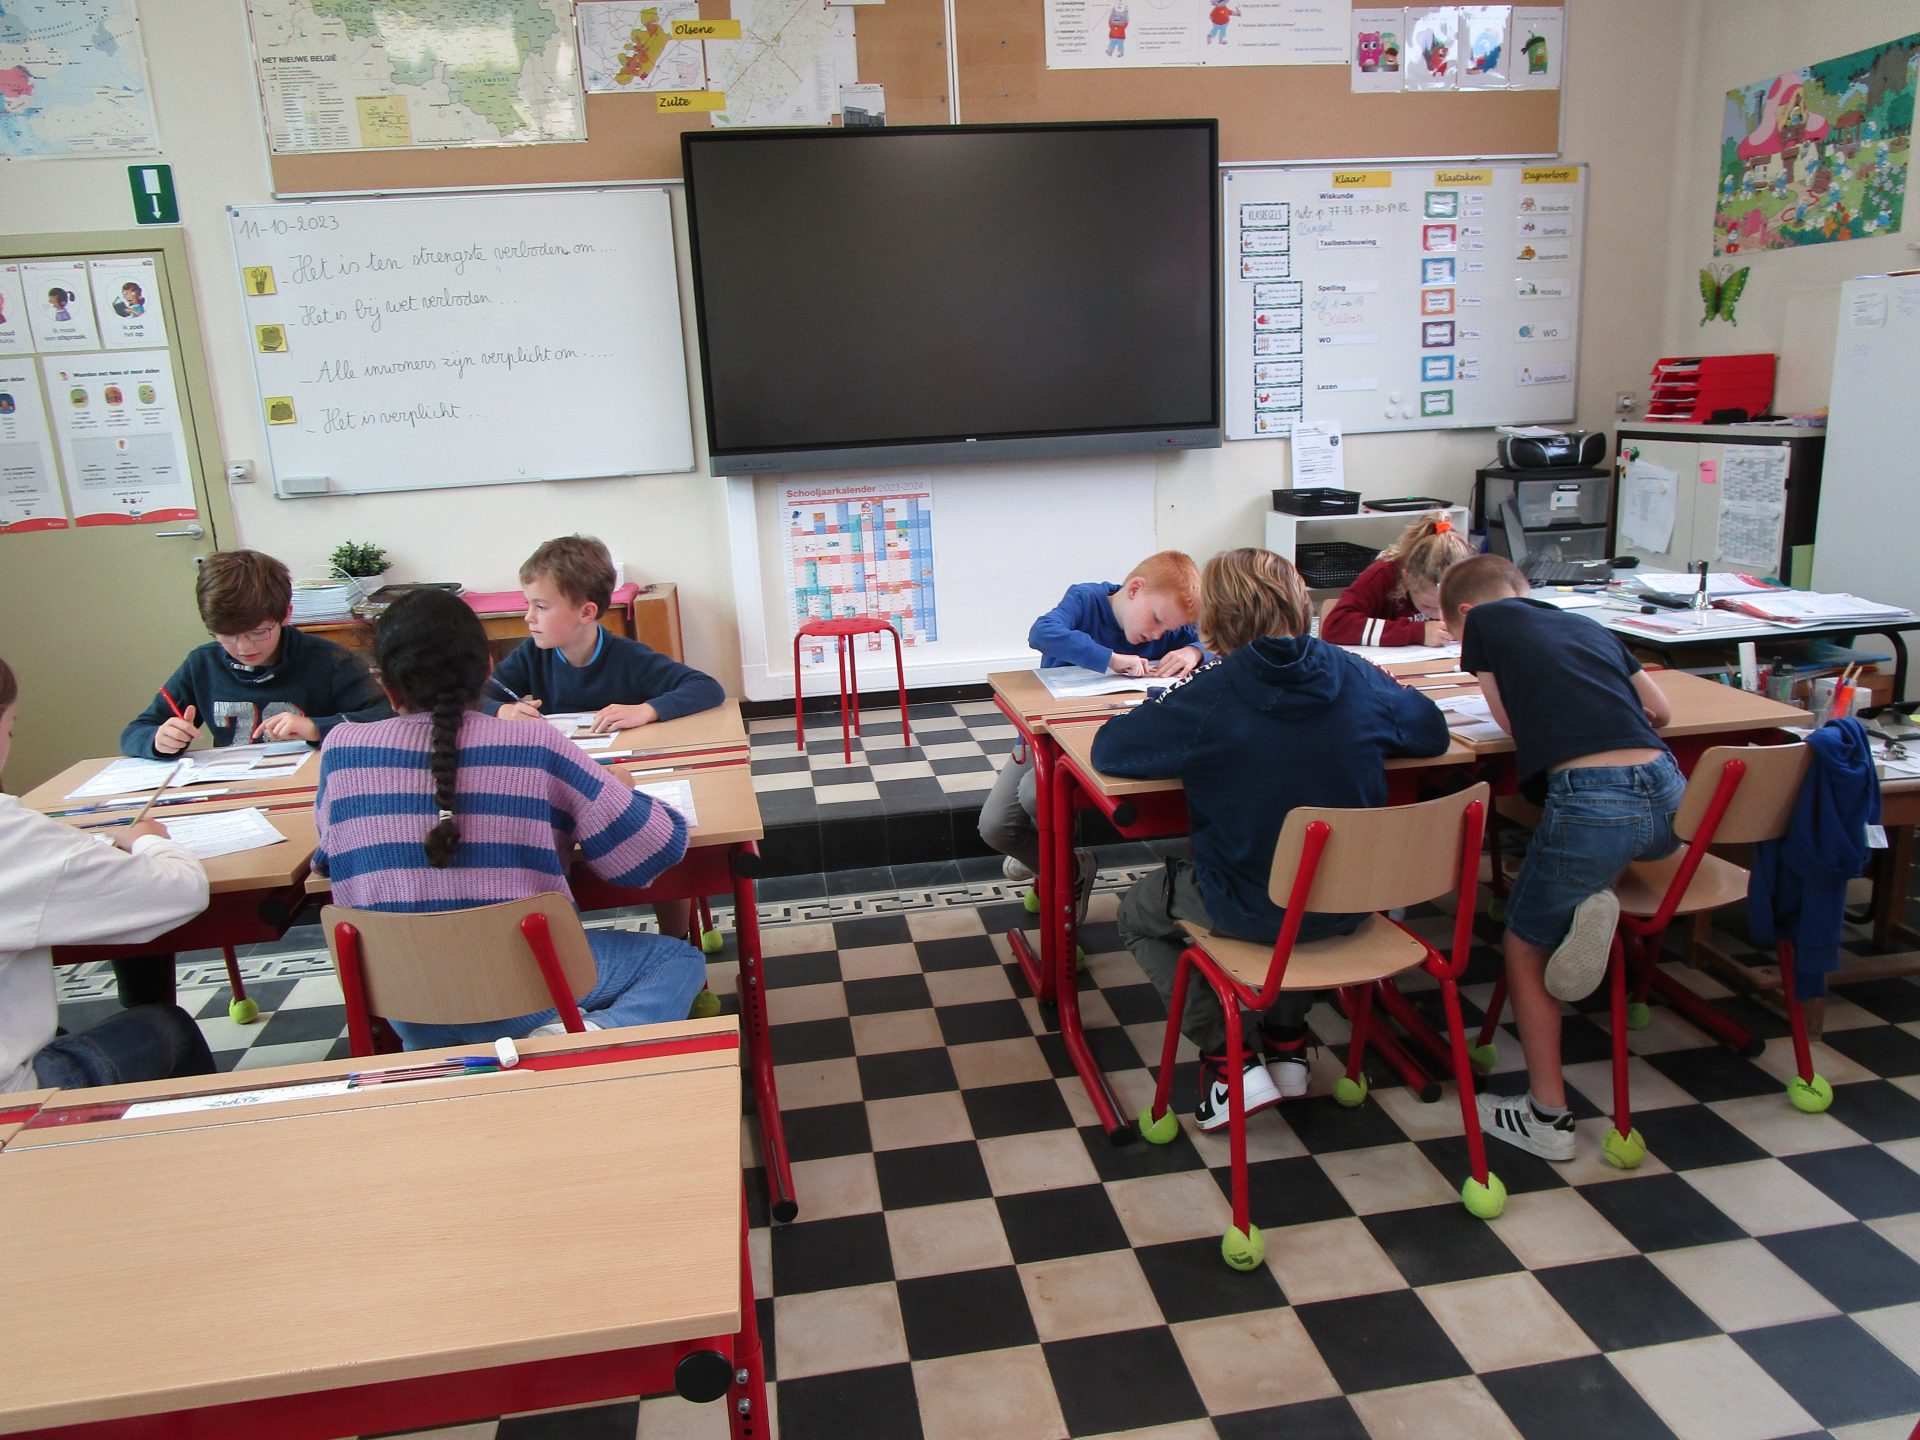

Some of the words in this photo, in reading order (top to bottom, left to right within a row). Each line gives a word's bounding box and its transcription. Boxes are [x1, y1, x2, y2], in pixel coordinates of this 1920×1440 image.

[675, 24, 715, 35] Olsene
[261, 56, 277, 64] HET
[279, 55, 309, 63] NIEUWE
[310, 53, 337, 62] BELGIË
[660, 96, 691, 108] Zulte
[1334, 174, 1366, 184] Klaar?
[1437, 172, 1483, 183] Klastaken
[1523, 170, 1569, 182] Dagverloop
[1319, 191, 1354, 199] Wiskunde
[240, 215, 339, 239] 11-10-2023
[1320, 239, 1377, 247] Taalbeschouwing
[289, 254, 333, 285] Het
[338, 257, 360, 274] is
[366, 251, 402, 271] ten
[412, 243, 487, 276] strengste
[1317, 284, 1346, 292] Spelling
[299, 304, 333, 327] Het
[333, 302, 348, 320] is
[355, 296, 384, 333] bij
[385, 294, 419, 315] wet
[421, 288, 492, 309] verboden
[1542, 329, 1558, 337] WO
[316, 360, 359, 384] Alle
[442, 351, 476, 379] zijn
[480, 344, 552, 368] verplicht
[554, 348, 579, 360] om
[321, 407, 357, 432] Het
[360, 406, 378, 424] is
[378, 402, 461, 429] verplicht
[786, 486, 877, 498] Schooljaarkalender
[878, 482, 924, 493] 2023-2024
